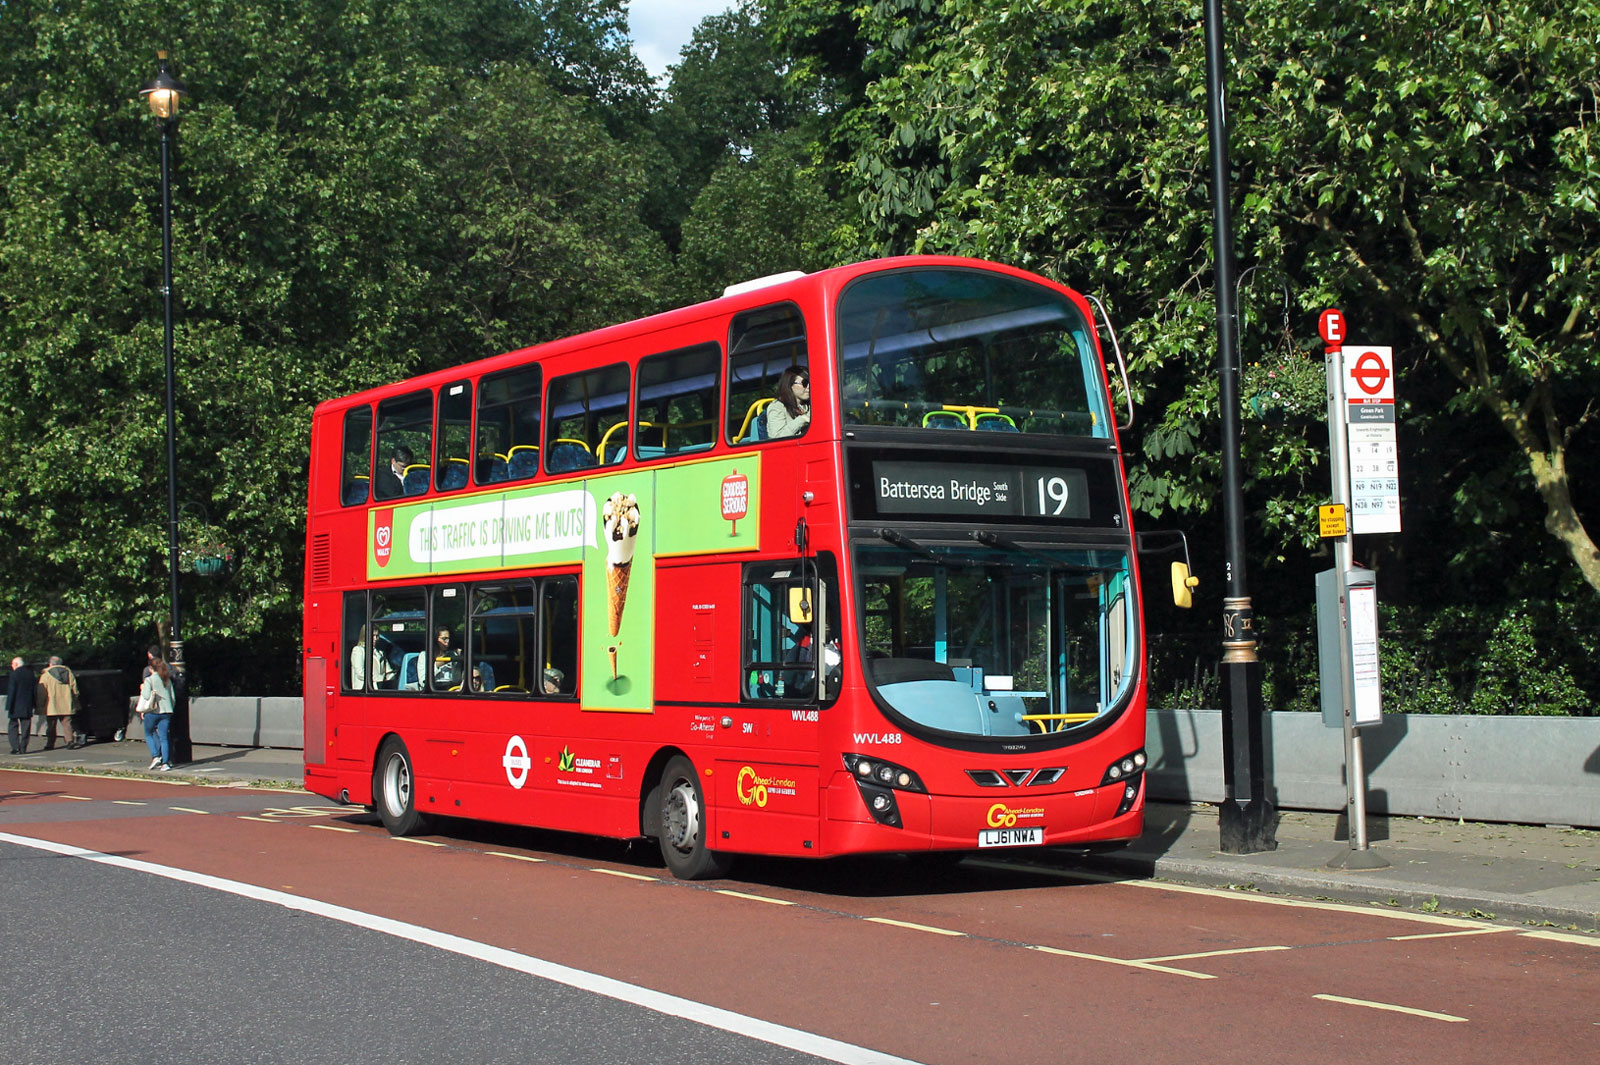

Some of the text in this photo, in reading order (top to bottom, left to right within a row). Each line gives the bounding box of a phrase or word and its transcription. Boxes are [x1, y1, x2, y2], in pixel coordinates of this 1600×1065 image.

[1327, 314, 1341, 340] E
[880, 477, 991, 506] Battersea Bridge
[993, 482, 1008, 491] South
[995, 492, 1007, 502] Side
[1037, 476, 1068, 515] 19
[722, 496, 746, 514] SERIOUS
[420, 508, 583, 552] THIS TRAFFIC IS DRIVING ME NUTS
[792, 710, 819, 722] WVL488
[742, 722, 753, 733] SW
[853, 733, 902, 744] WVL488
[987, 803, 1017, 828] Go
[986, 829, 1035, 844] LJ61 NWA
